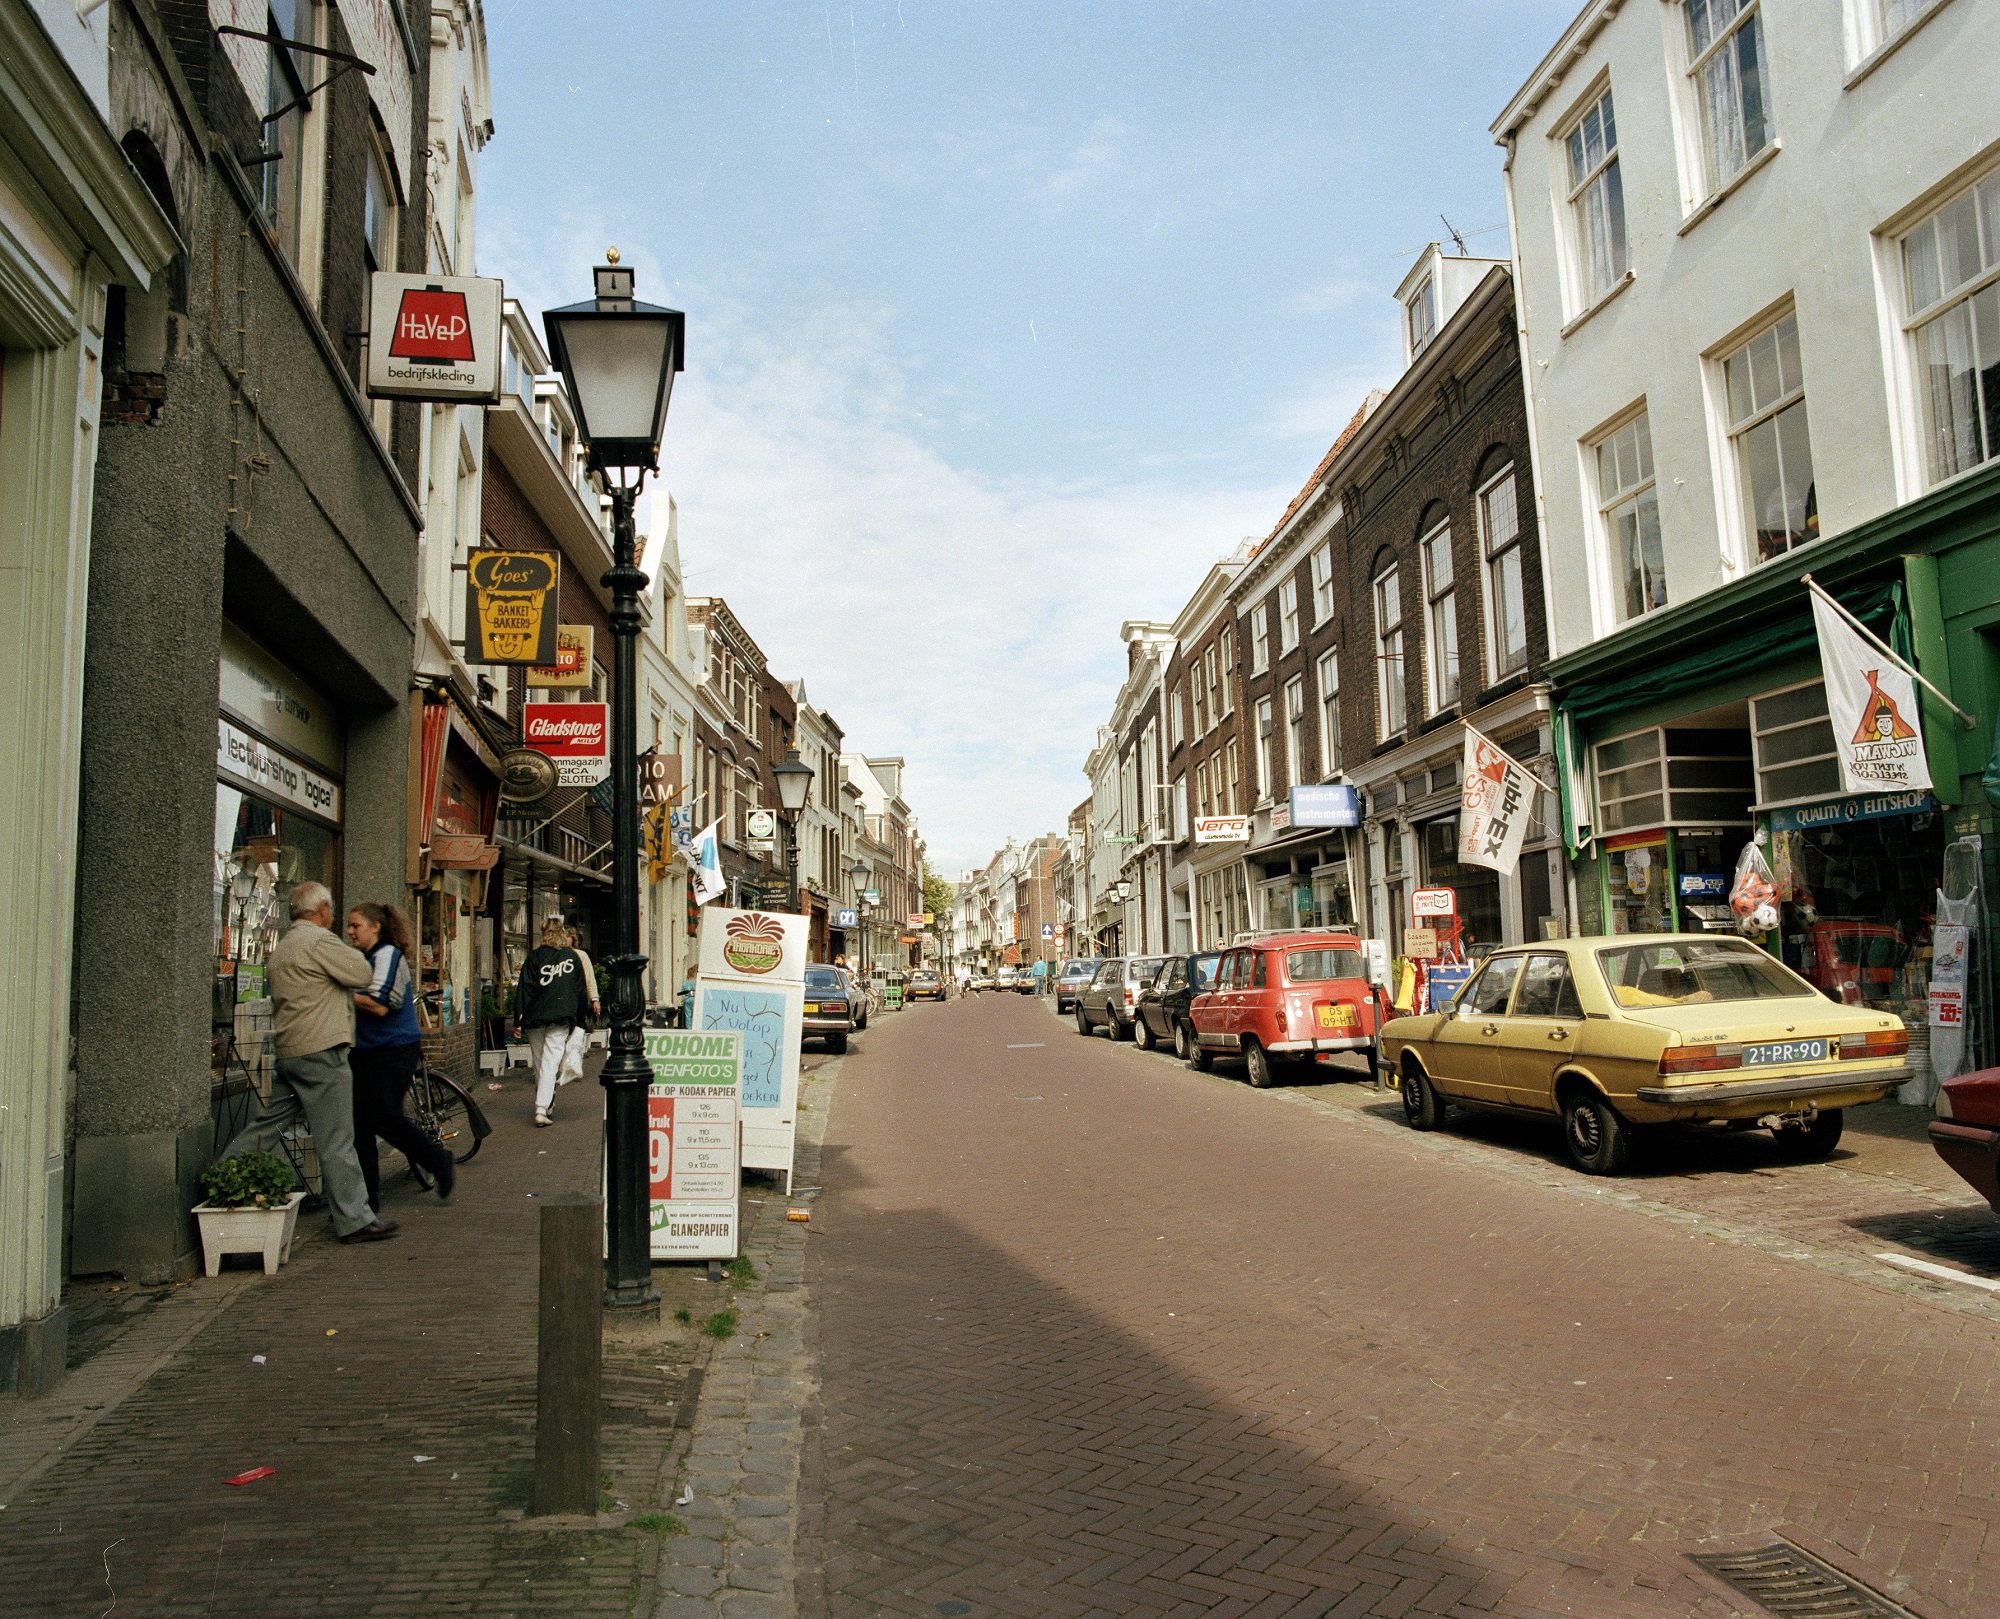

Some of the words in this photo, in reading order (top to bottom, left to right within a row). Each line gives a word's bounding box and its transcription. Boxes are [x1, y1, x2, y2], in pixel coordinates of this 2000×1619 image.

[401, 313, 467, 341] HaVeP
[388, 366, 475, 385] bedrijfskleding
[497, 605, 530, 617] BANKET
[493, 617, 530, 629] BAKKERIJ
[557, 655, 573, 665] IO
[529, 718, 602, 736] Gladstone
[227, 728, 297, 796] lectuurshop
[555, 757, 603, 767] nmagazijn
[559, 775, 598, 784] SLOTEN
[1297, 791, 1340, 801] medische
[1296, 808, 1355, 820] instrumenten
[1796, 805, 1840, 826] QUALITY
[721, 999, 738, 1013] Nu
[1329, 1007, 1342, 1015] DS
[1322, 1016, 1352, 1026] 09-HT
[1749, 1042, 1821, 1063] 21-PR-90
[648, 1086, 661, 1095] KT
[664, 1086, 676, 1095] OP
[679, 1086, 706, 1096] KODAK
[708, 1087, 736, 1096] PAPIER
[671, 1223, 729, 1237] GLANSPAPIER
